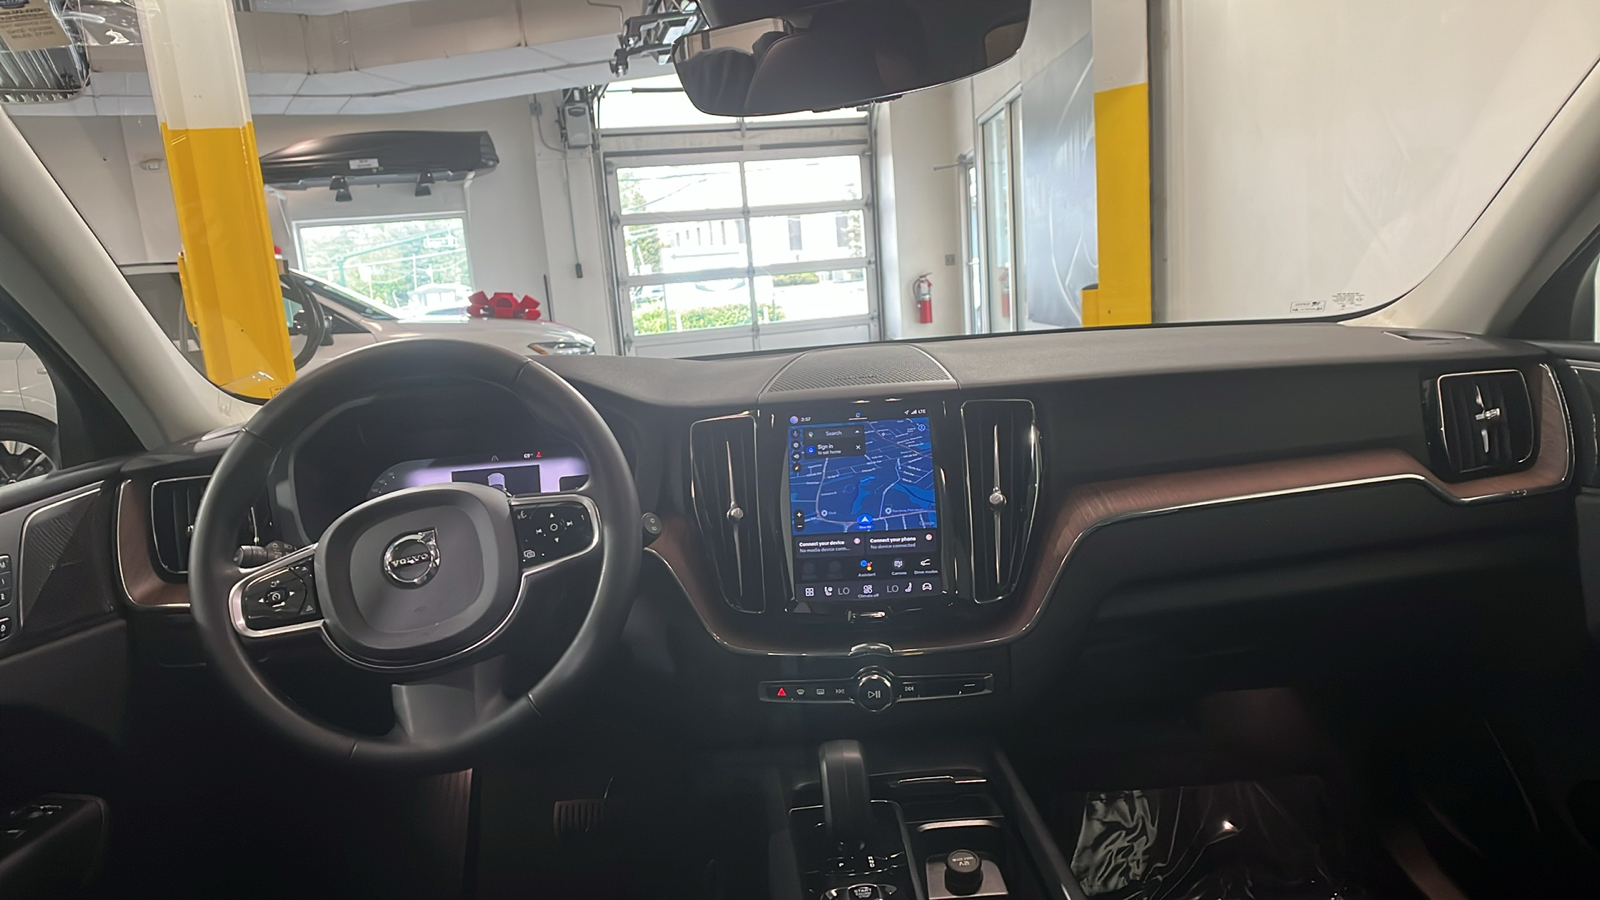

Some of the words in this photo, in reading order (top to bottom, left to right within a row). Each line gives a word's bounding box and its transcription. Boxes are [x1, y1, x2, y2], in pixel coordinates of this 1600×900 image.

[391, 552, 430, 567] VOLVO
[838, 587, 850, 595] LO
[887, 585, 899, 593] LO
